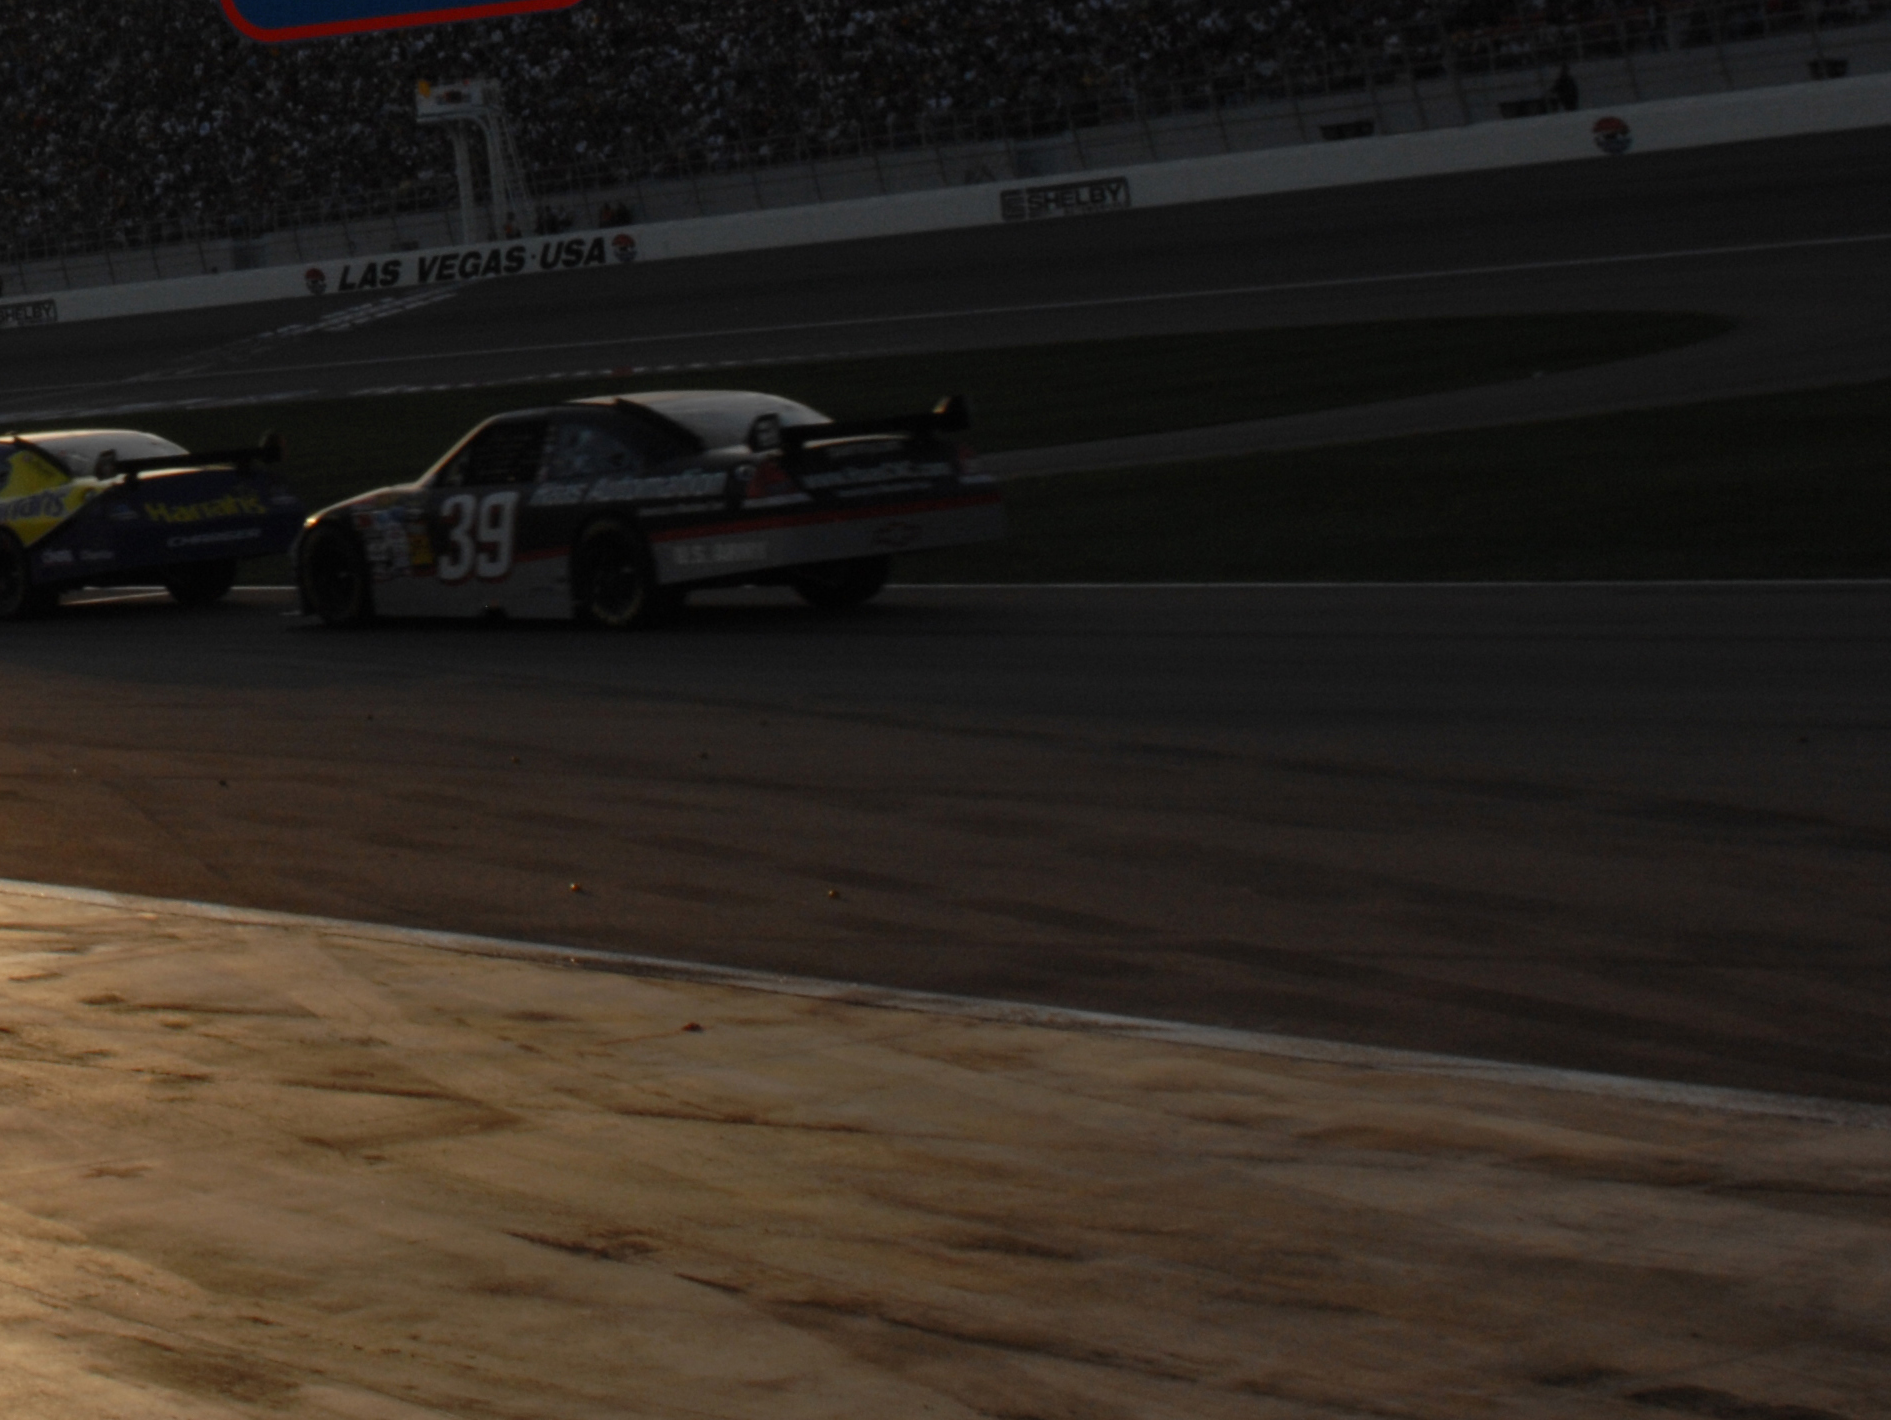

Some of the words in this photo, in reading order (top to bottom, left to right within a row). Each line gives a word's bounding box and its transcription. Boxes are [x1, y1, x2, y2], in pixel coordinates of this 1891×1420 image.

[1027, 183, 1122, 210] SHELBY
[339, 260, 402, 291] LAS
[417, 246, 526, 283] VEGAS
[540, 237, 607, 269] USA
[438, 491, 520, 580] 39
